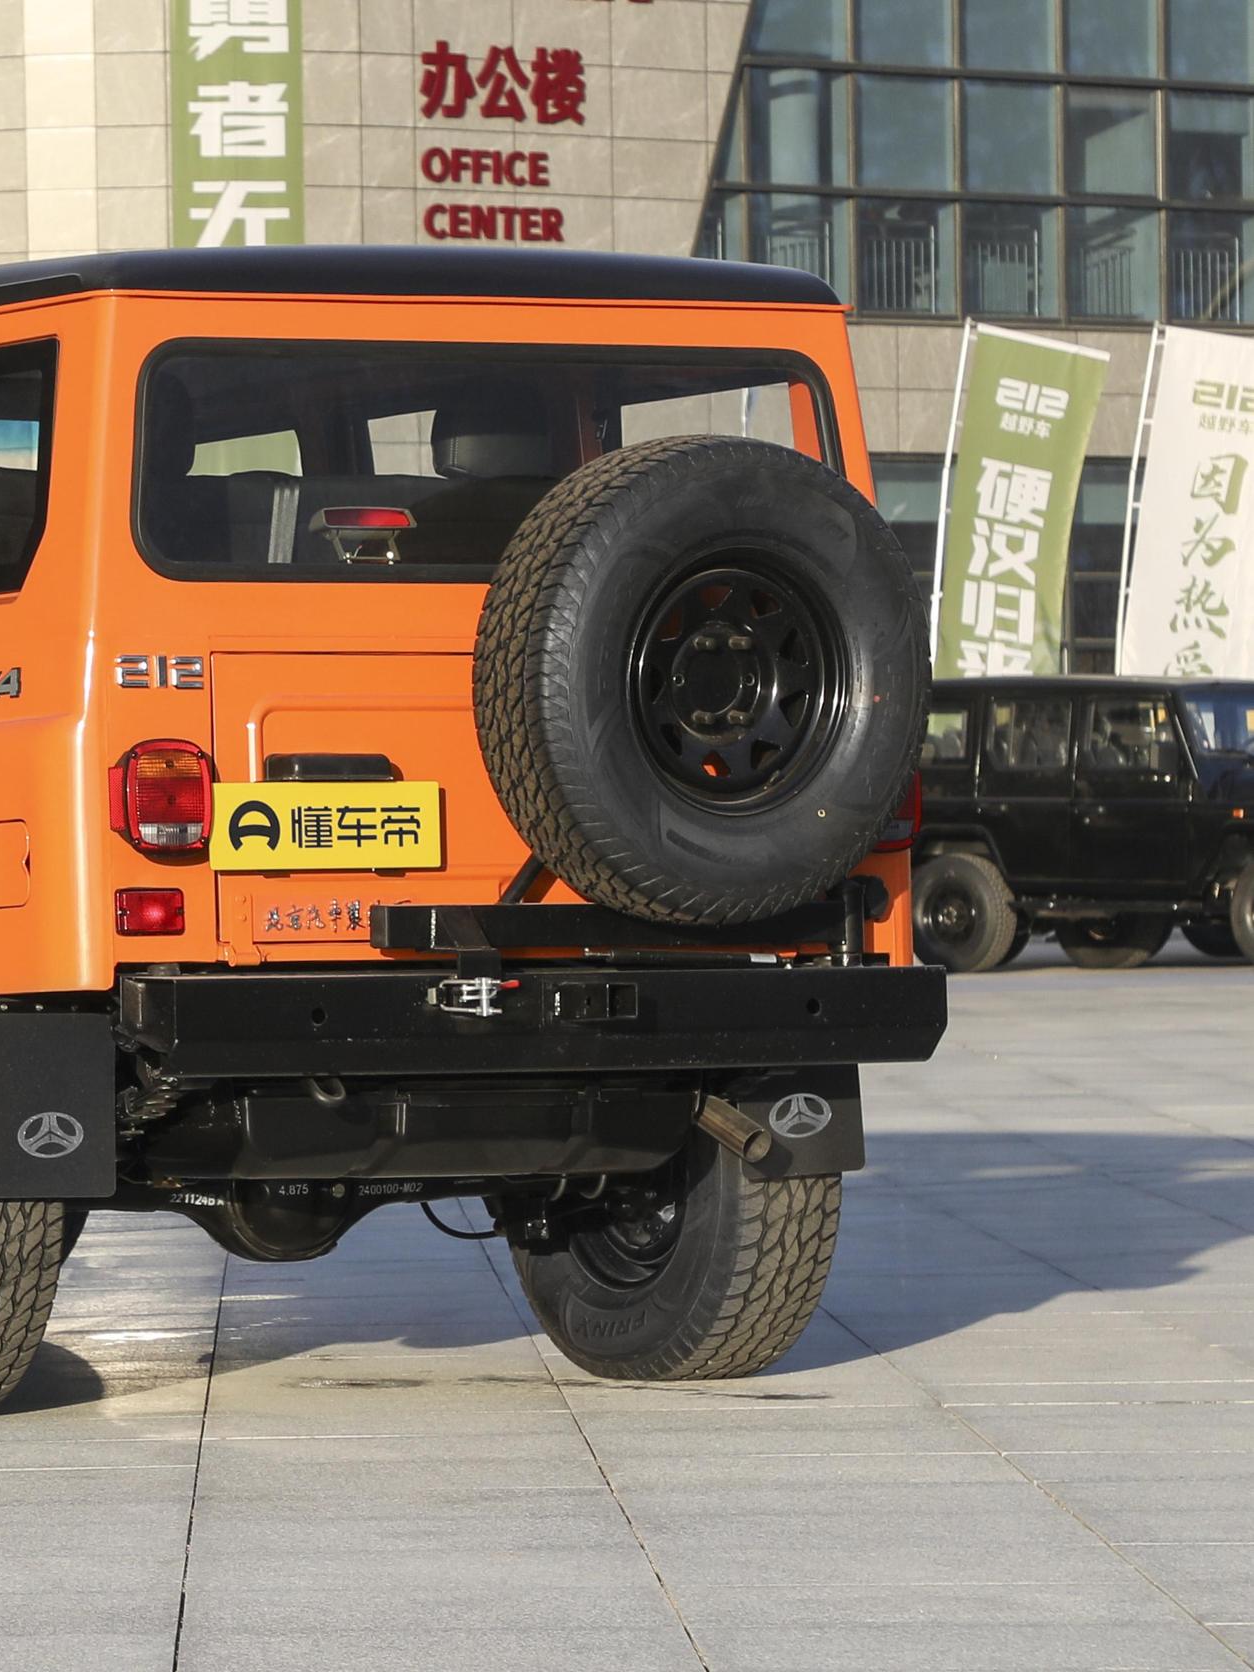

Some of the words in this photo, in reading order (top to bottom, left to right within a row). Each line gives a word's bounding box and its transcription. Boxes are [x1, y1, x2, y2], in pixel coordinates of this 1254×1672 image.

[420, 40, 587, 126] 办公楼
[421, 147, 550, 187] OFFICE
[423, 204, 564, 243] CENTER
[995, 377, 1069, 418] 212
[999, 413, 1052, 439] 越野车
[115, 655, 204, 689] 212
[291, 805, 421, 849] 懂车帝
[278, 1184, 310, 1196] 4.875
